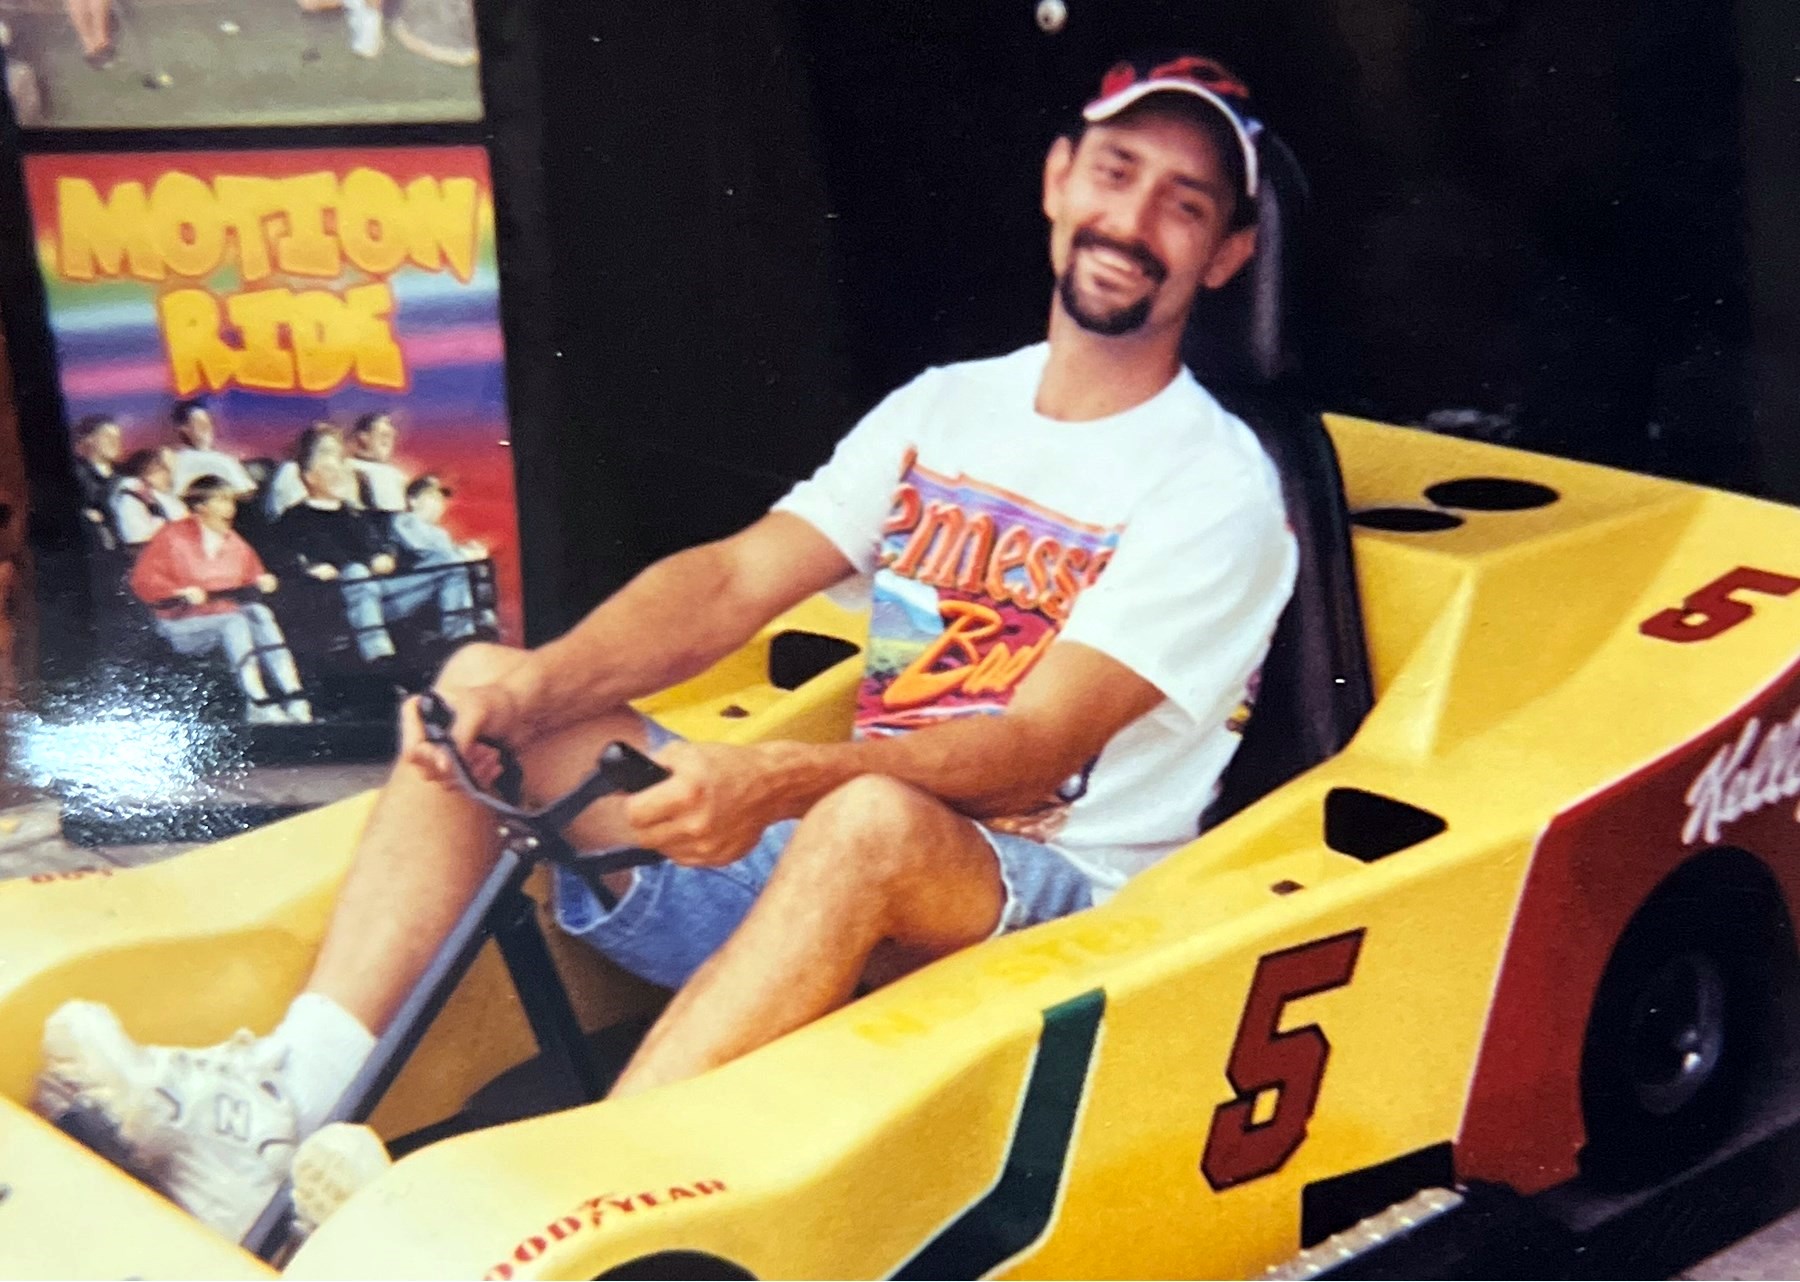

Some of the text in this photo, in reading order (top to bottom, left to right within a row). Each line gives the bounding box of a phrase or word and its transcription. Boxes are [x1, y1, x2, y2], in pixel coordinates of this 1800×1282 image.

[56, 167, 478, 285] MOTION
[159, 282, 408, 396] RIDE
[1640, 566, 1800, 643] 5
[1200, 926, 1368, 1193] 5
